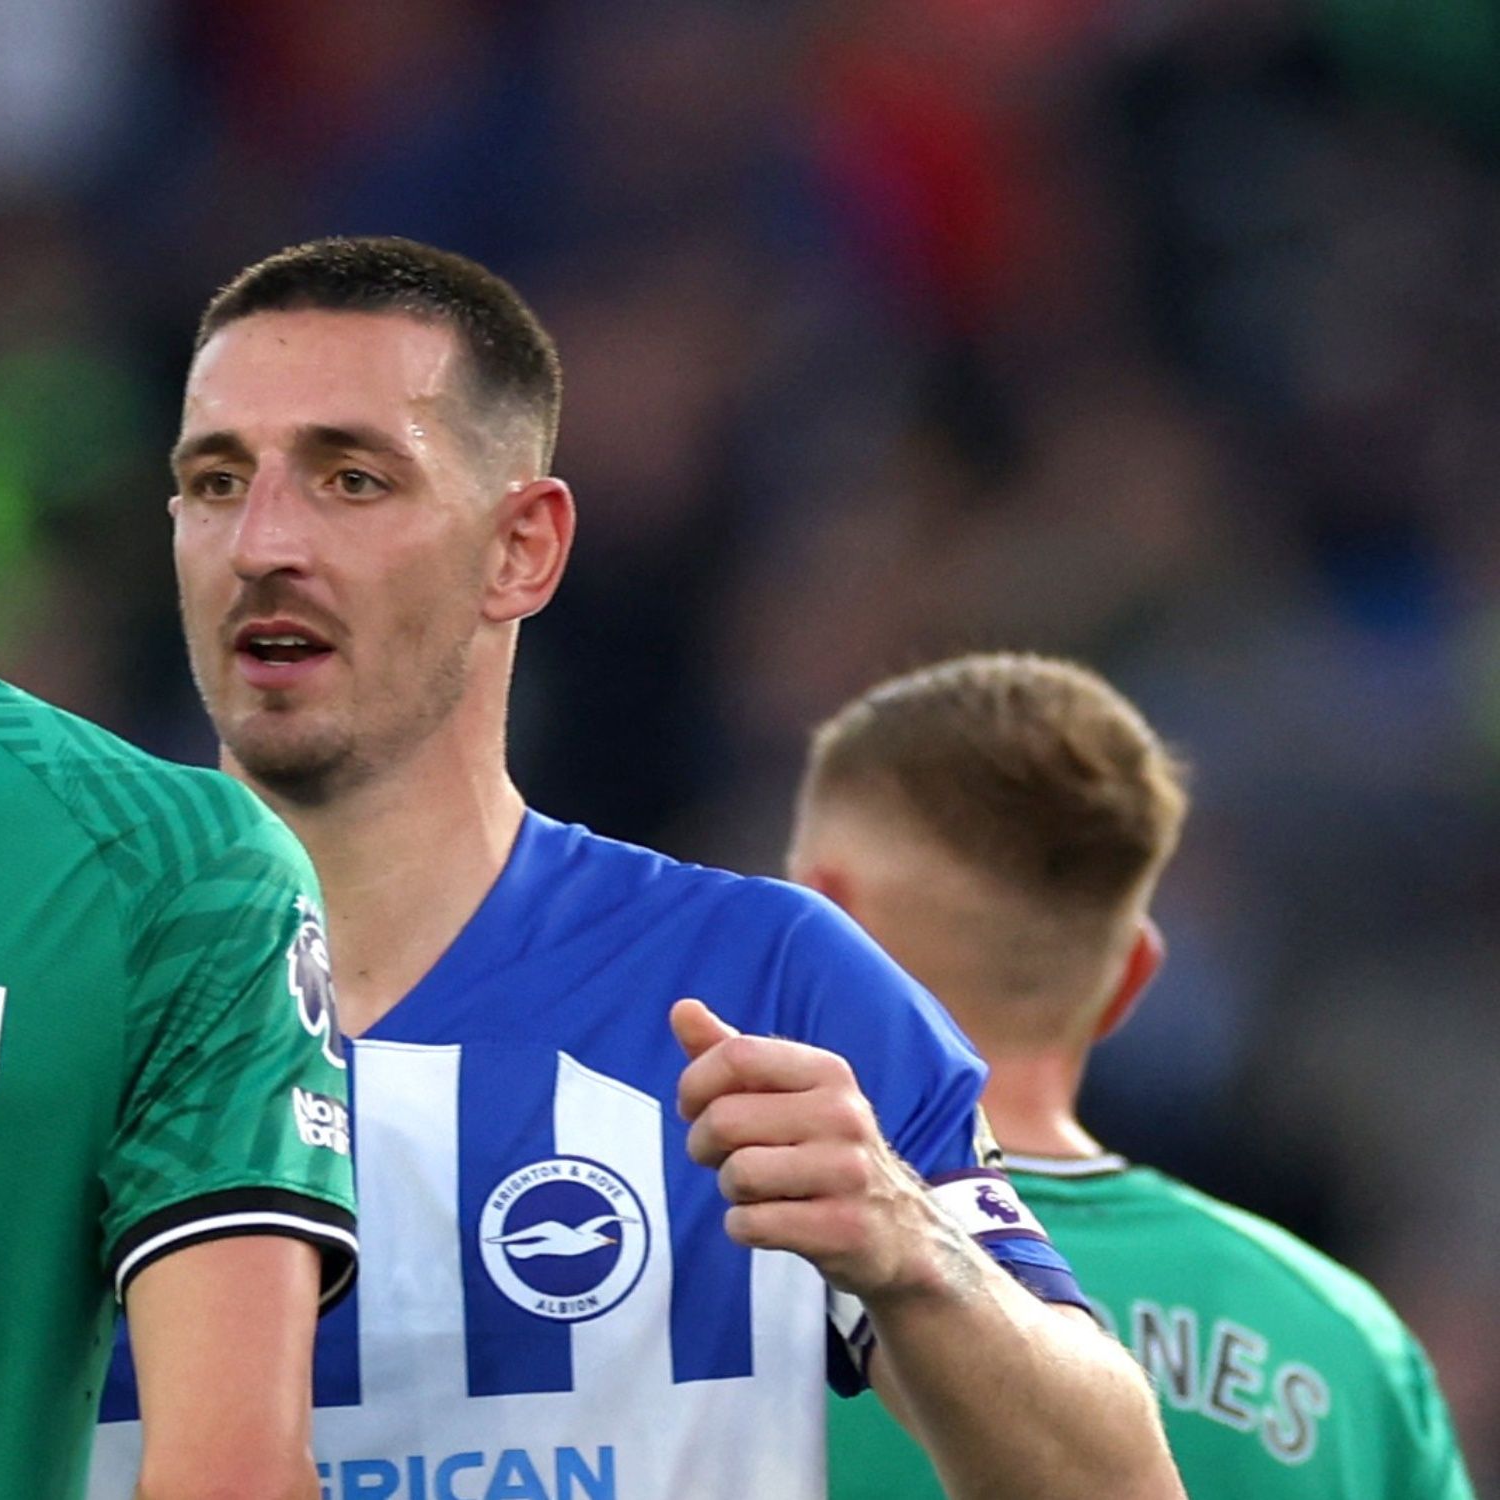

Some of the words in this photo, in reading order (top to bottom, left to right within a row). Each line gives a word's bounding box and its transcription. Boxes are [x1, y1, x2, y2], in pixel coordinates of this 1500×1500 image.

[492, 1165, 561, 1211] BRIGHTON
[568, 1165, 580, 1177] &
[586, 1172, 625, 1201] HOVE
[535, 1295, 599, 1314] ALBION
[1088, 1297, 1331, 1466] NES
